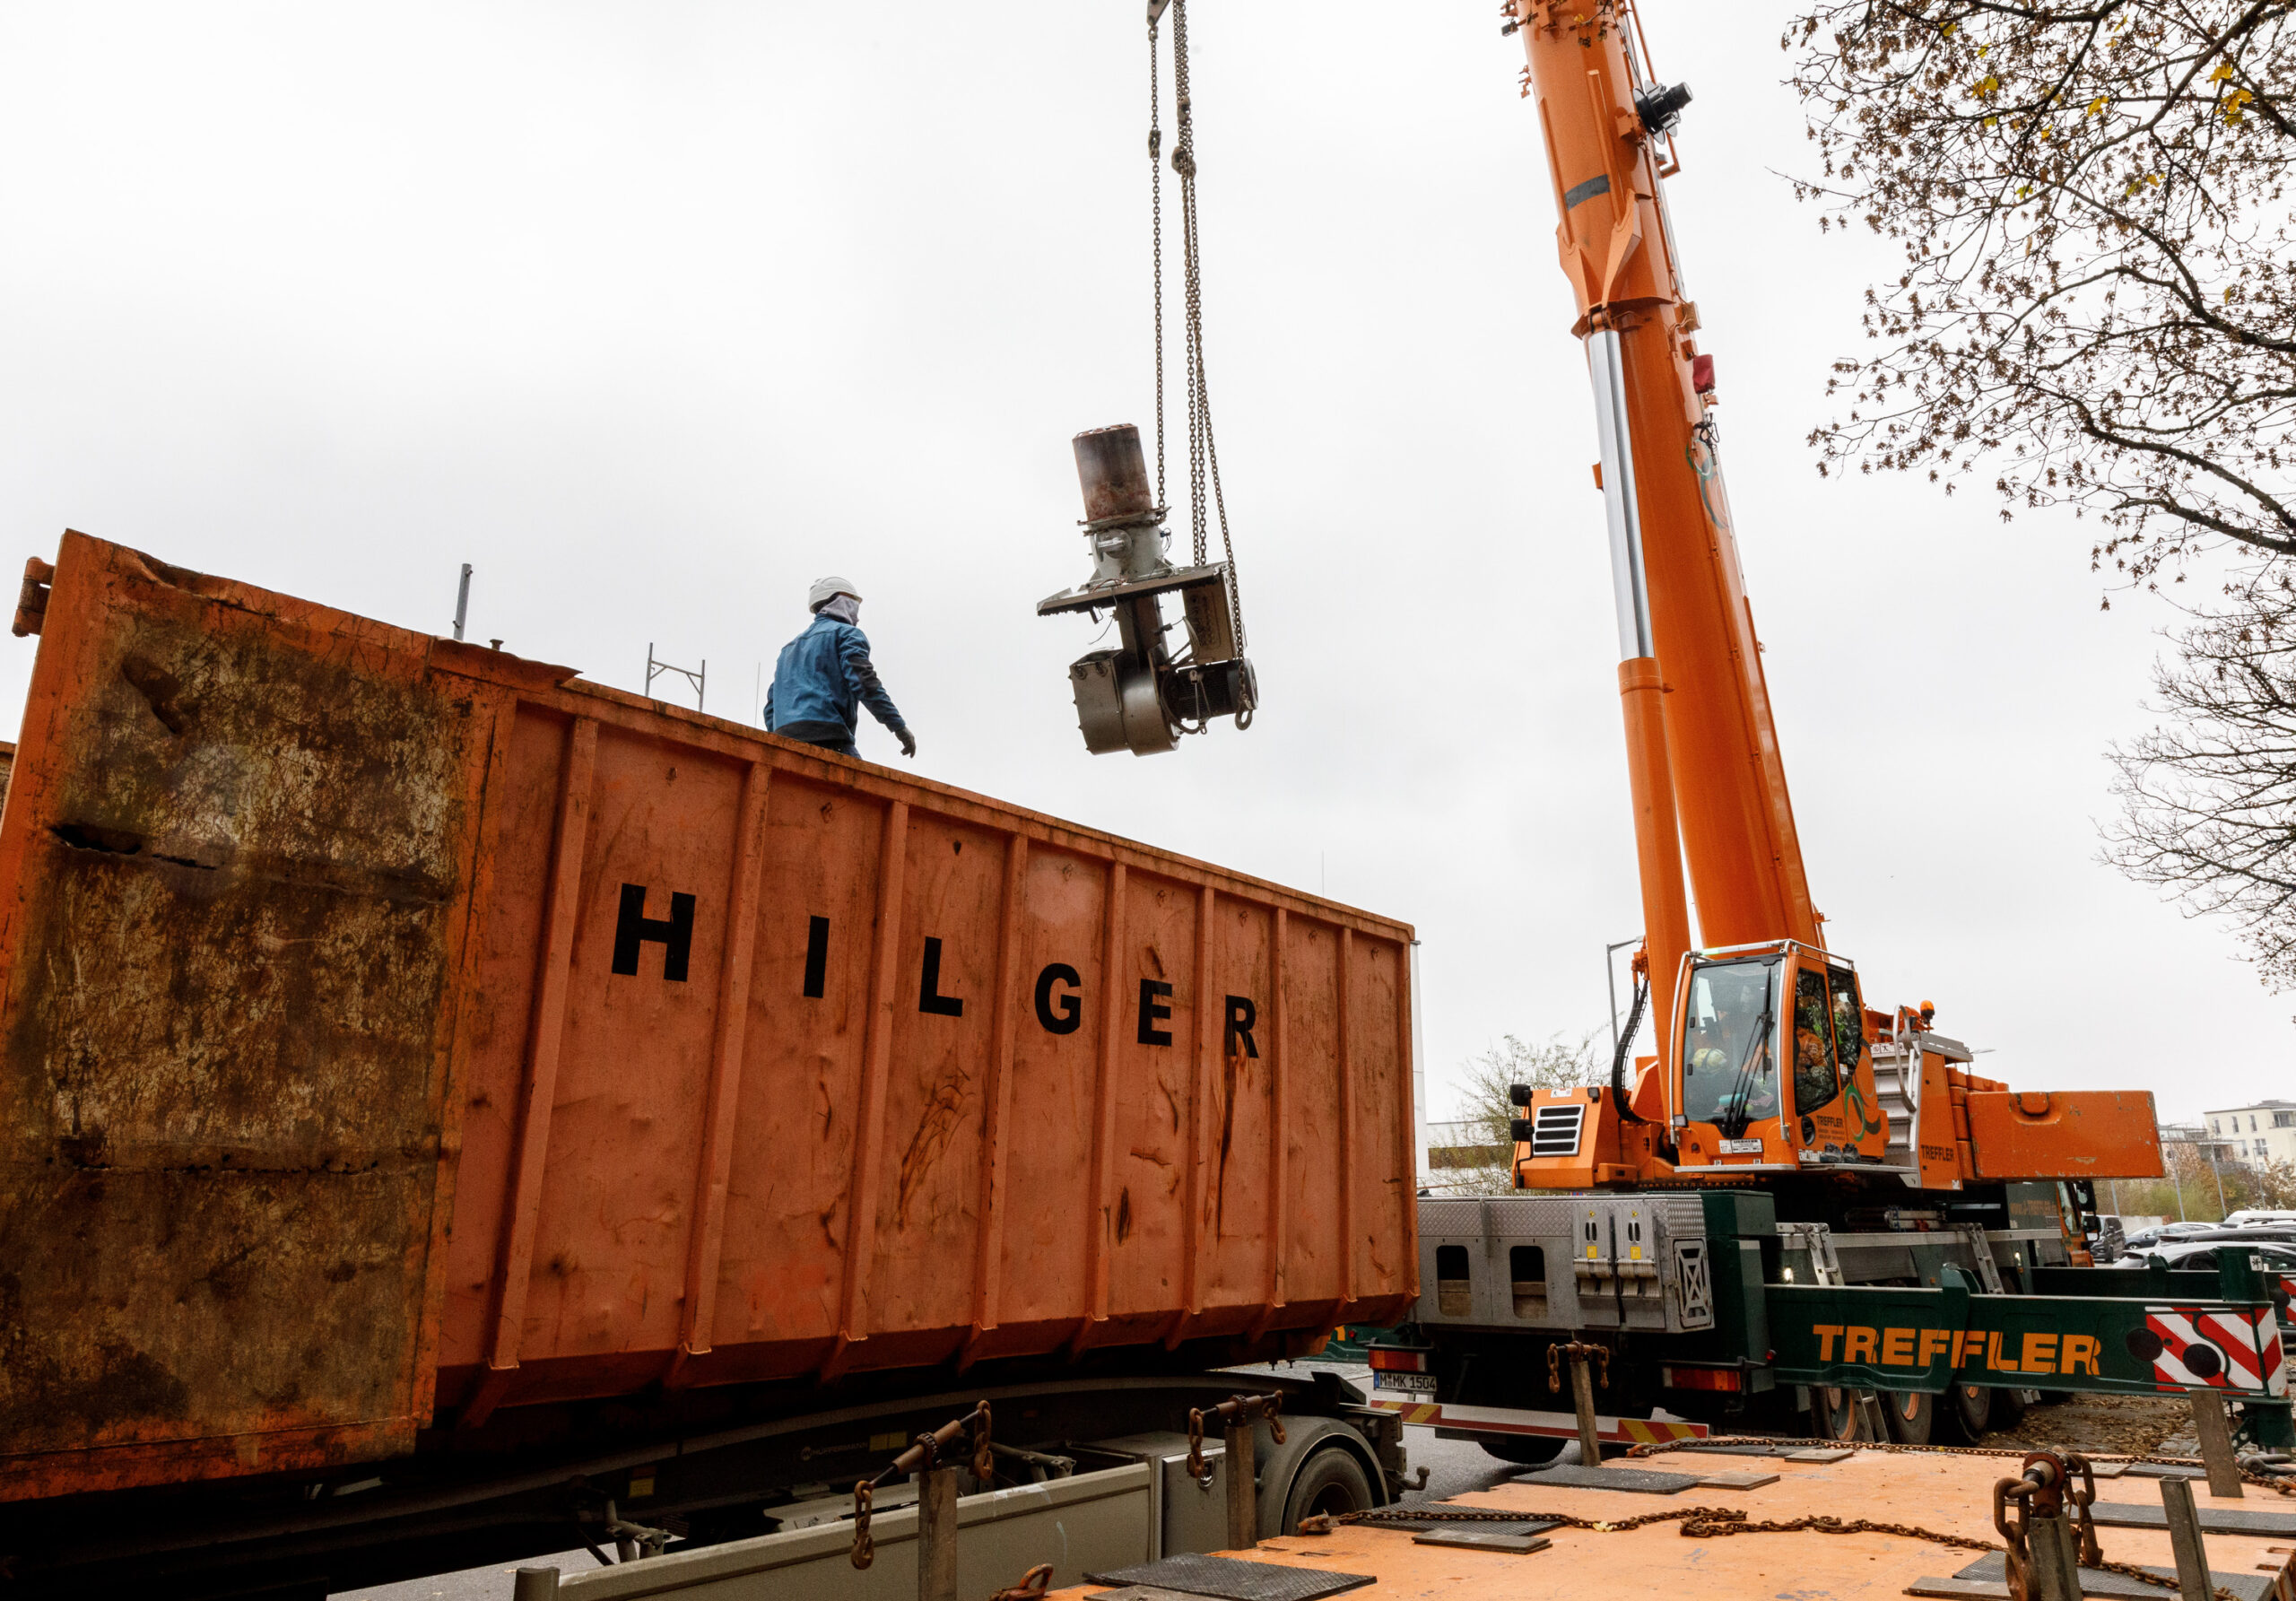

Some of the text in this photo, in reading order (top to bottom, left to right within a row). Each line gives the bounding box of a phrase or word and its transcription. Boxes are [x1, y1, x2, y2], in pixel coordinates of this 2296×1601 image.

[611, 882, 1260, 1058] HILGER
[1816, 1115, 1844, 1128] TREFFLER
[1921, 1144, 1954, 1162] TREFFLER
[1813, 1324, 2101, 1376] TREFFLER
[1410, 1377, 1436, 1390] 1504
